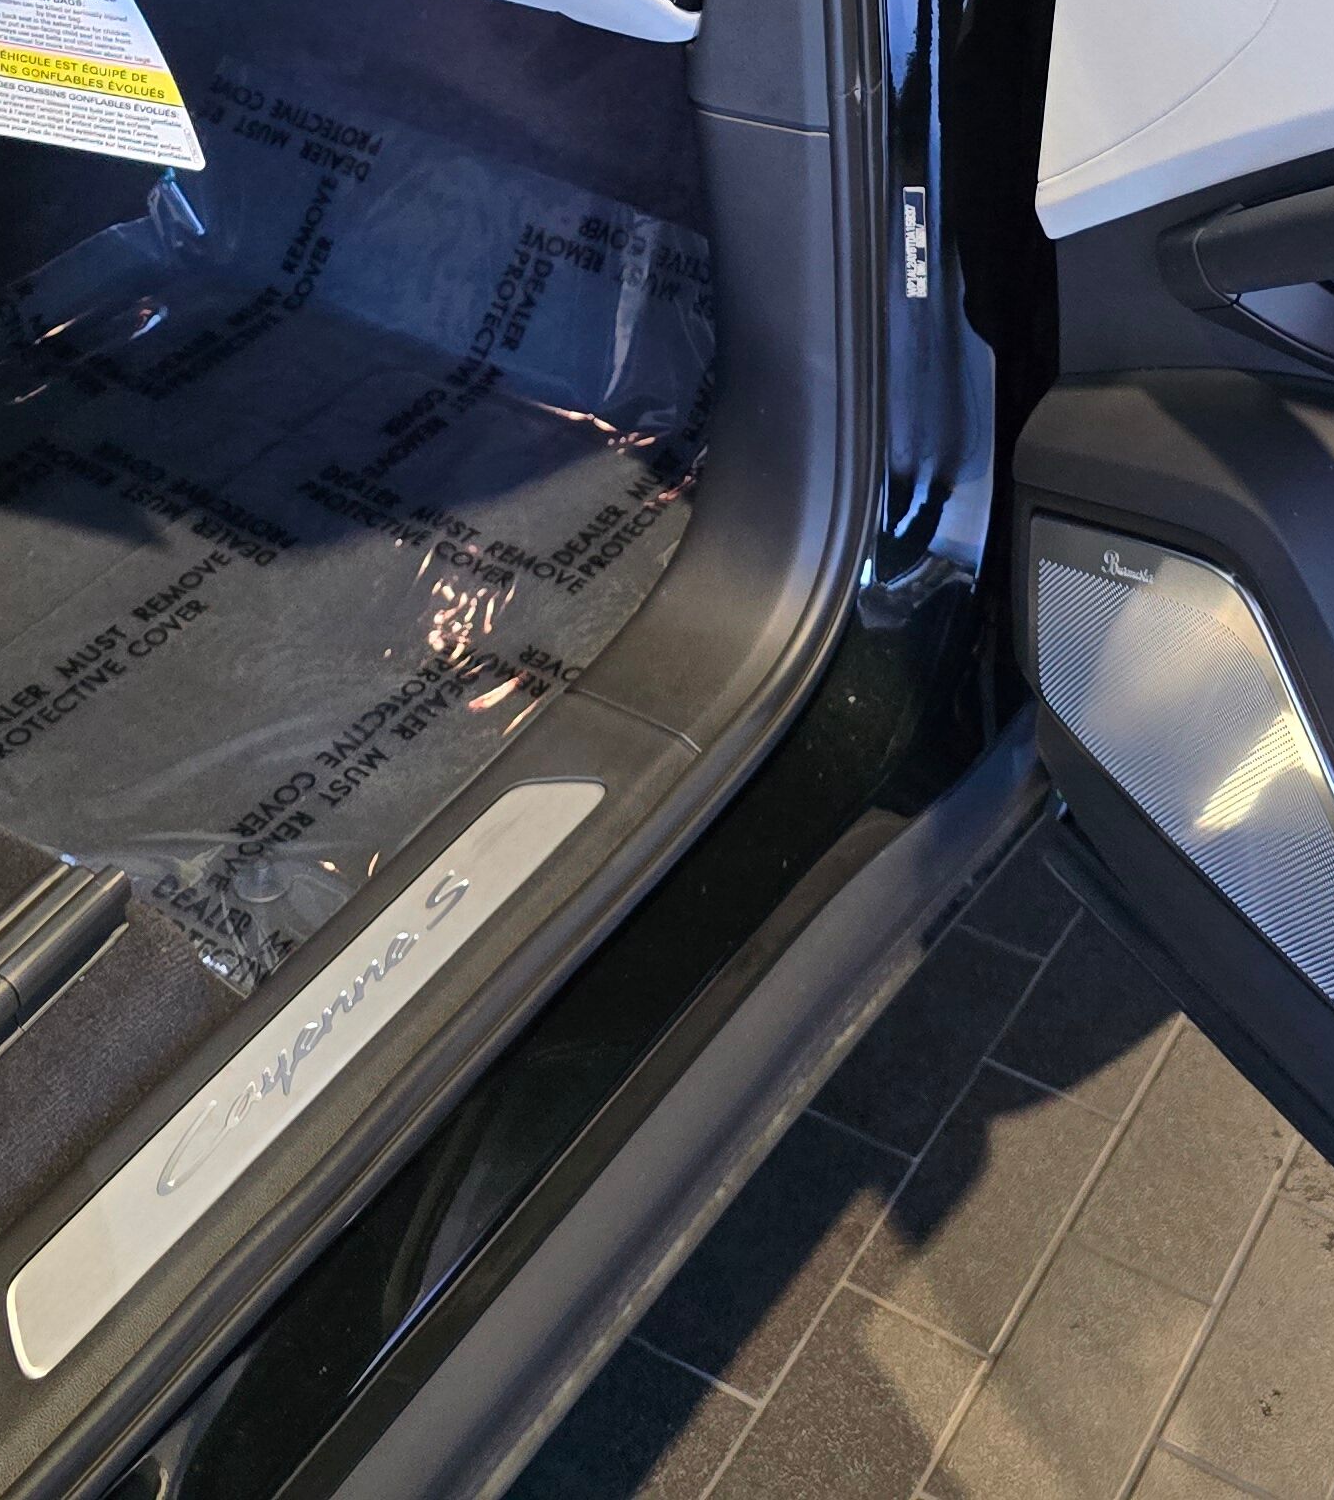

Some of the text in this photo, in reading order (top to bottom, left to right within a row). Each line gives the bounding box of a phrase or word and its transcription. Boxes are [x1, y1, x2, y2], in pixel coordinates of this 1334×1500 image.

[17, 84, 65, 99] COUSSINS
[68, 93, 131, 109] GONFLABLES
[21, 67, 104, 89] GONFLABLES
[107, 81, 165, 99] ÉVOLUÉS
[55, 59, 78, 71] EST
[82, 63, 127, 80] ÉQUIPÉ
[131, 72, 148, 83] DE
[233, 115, 291, 149] MUST
[269, 98, 384, 156] PROTECTIVE
[298, 140, 372, 184] DEALER
[281, 175, 339, 275] REMOVE
[519, 222, 606, 274] REMOVE
[282, 236, 334, 310] COVER
[500, 258, 554, 352] DEALER
[192, 514, 276, 566] DEALER
[409, 505, 482, 544] MUST
[484, 540, 587, 596] REMOVE
[435, 540, 515, 588] COVER
[553, 504, 628, 566] DEALER
[55, 624, 128, 680] MUST
[130, 550, 232, 623] REMOVE
[127, 599, 210, 658] COVER
[518, 644, 584, 682] OVER
[316, 657, 454, 769] PROTECTIVE
[391, 668, 479, 741] DEALER
[230, 771, 316, 838] COVER
[318, 747, 392, 807] MUST
[157, 930, 422, 1197] Cayenne
[425, 867, 469, 931] S
